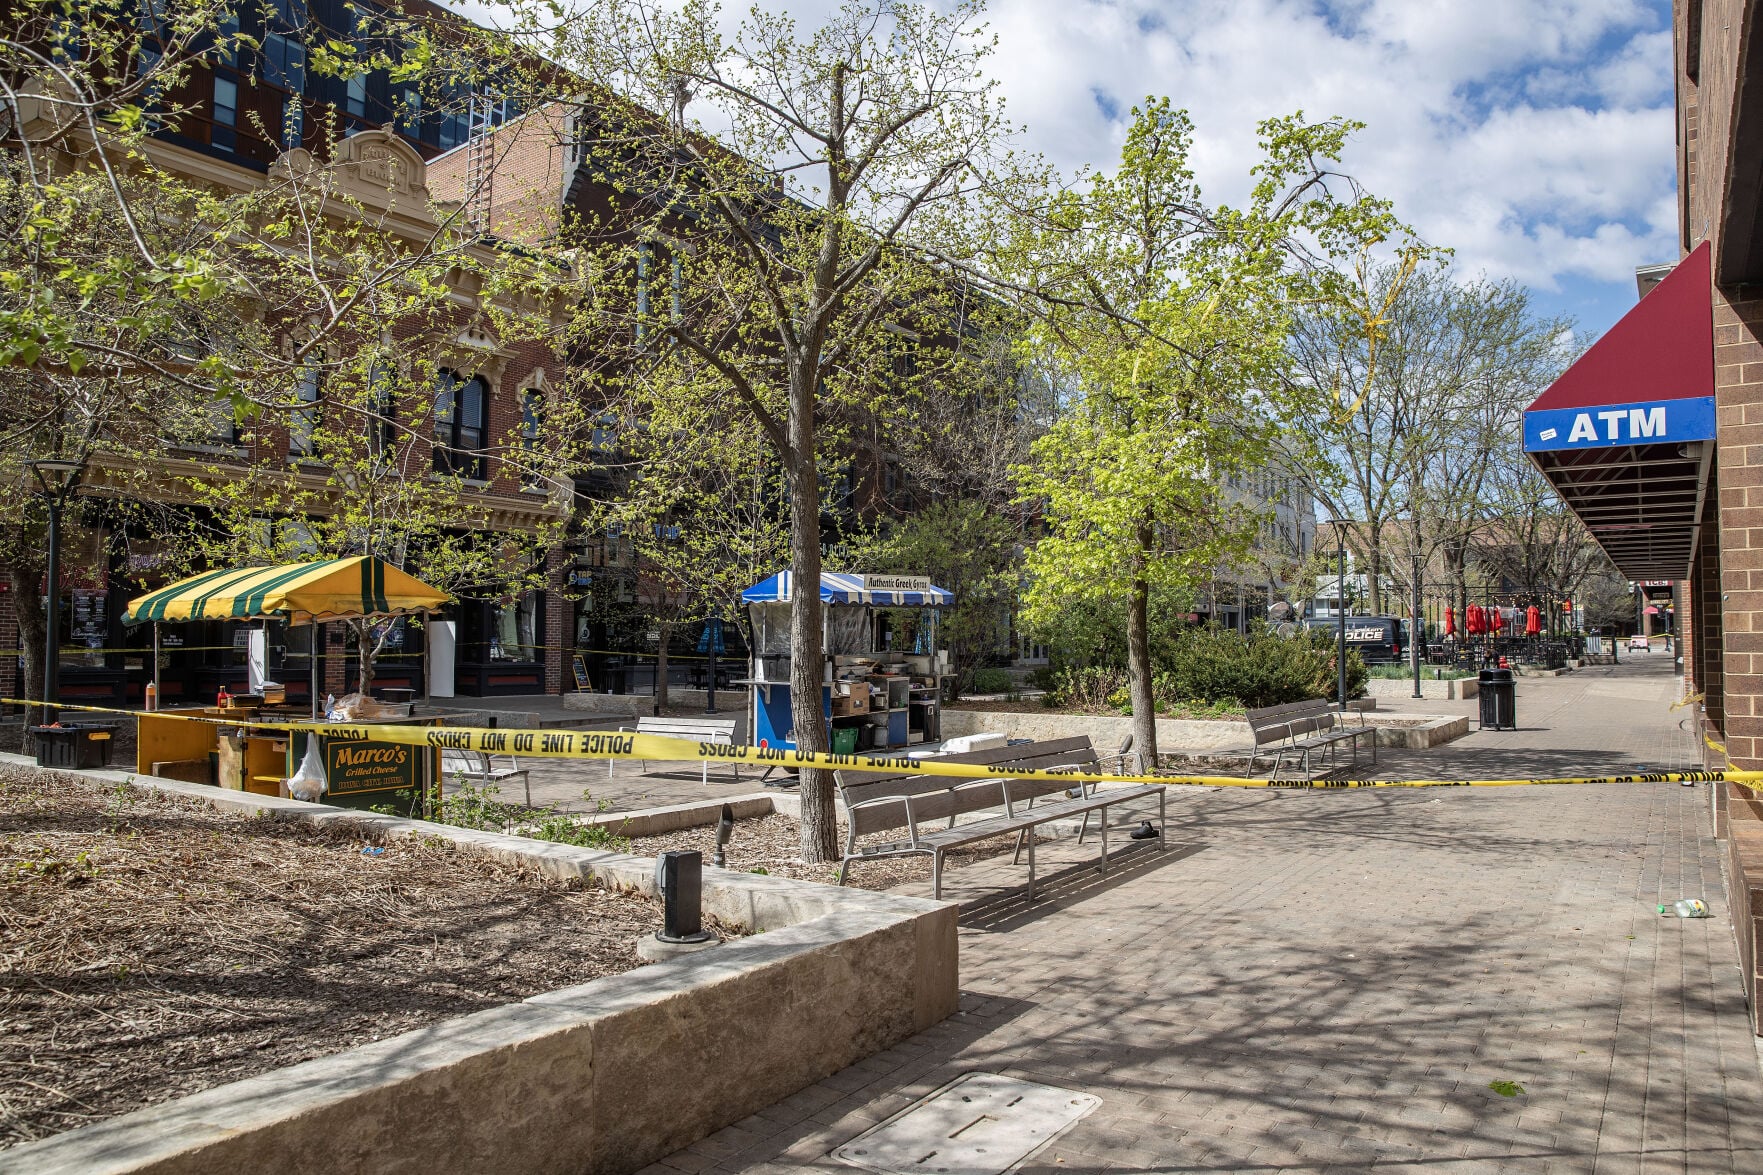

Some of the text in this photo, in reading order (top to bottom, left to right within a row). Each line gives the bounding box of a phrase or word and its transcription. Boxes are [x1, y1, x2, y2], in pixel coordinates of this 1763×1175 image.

[1567, 406, 1667, 443] ATM
[868, 577, 895, 588] Authentic
[895, 578, 912, 589] Greek
[427, 731, 634, 755] POLICE LINE DO NOT CROSS
[698, 742, 748, 759] CROSS
[335, 744, 407, 769] Marco's
[756, 747, 786, 762] NOT
[345, 766, 398, 777] Grilled Cheese
